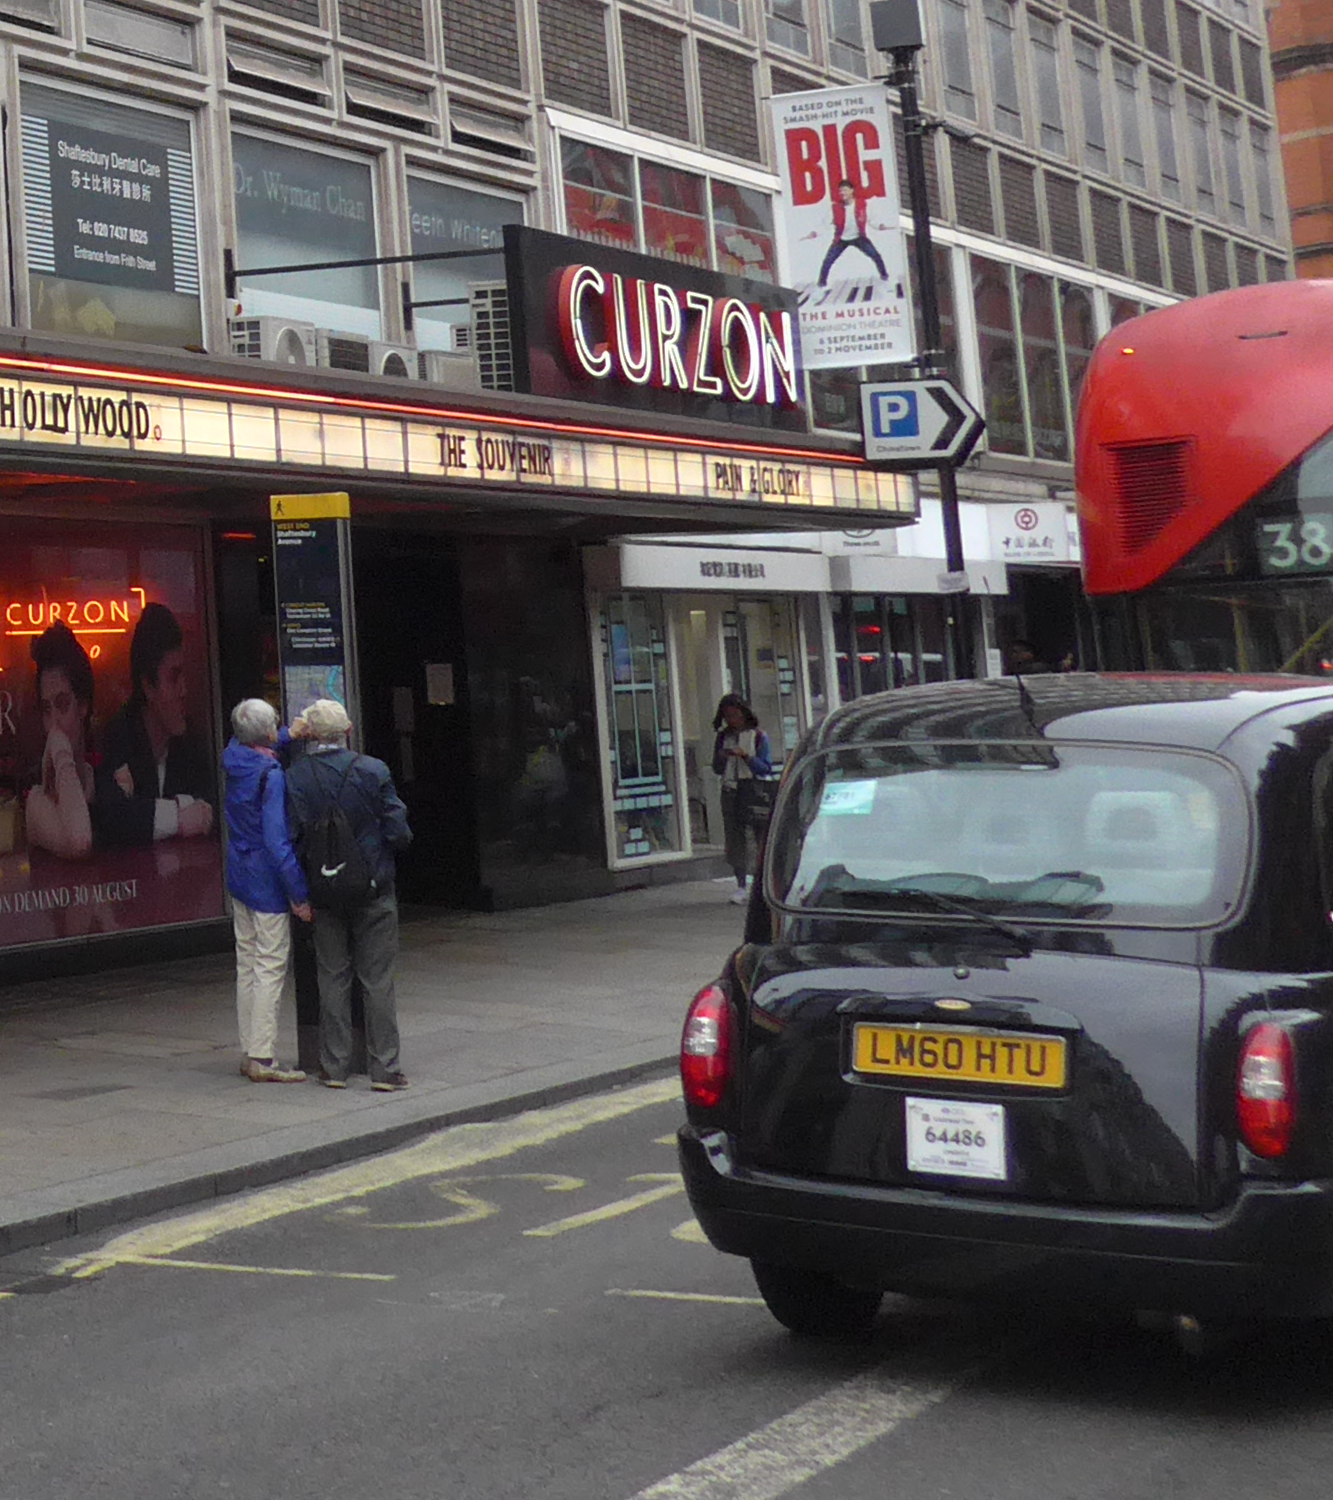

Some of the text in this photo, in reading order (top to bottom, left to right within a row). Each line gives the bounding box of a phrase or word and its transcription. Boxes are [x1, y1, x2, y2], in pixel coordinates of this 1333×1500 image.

[783, 106, 875, 124] SMASH-HIT MOVIE
[791, 97, 864, 112] BASED ON THE
[57, 140, 161, 178] Shaftesbury Dental Care
[784, 119, 886, 206] BIG
[233, 162, 366, 221] Dr. Wyman Chan
[77, 218, 92, 235] Tel:
[74, 245, 104, 262] Entrance
[105, 251, 120, 265] from
[137, 256, 156, 271] Street
[801, 306, 900, 322] THE MUSICAL
[802, 319, 902, 334] DOMINION THEATRE
[559, 264, 798, 405] CURZON
[827, 333, 886, 344] SEPTEMBER
[835, 342, 893, 353] NOVEMBER
[878, 395, 909, 433] P
[437, 432, 553, 477] THE SOUVENIR
[715, 461, 801, 496] PAIN & GLORY
[1262, 521, 1332, 568] 38
[5, 600, 130, 625] CURZON
[14, 887, 71, 914] DEMAND
[73, 887, 89, 906] 30
[92, 880, 139, 904] AUGUST
[870, 1032, 1047, 1078] LM60 HTU
[924, 1125, 987, 1149] 64486
